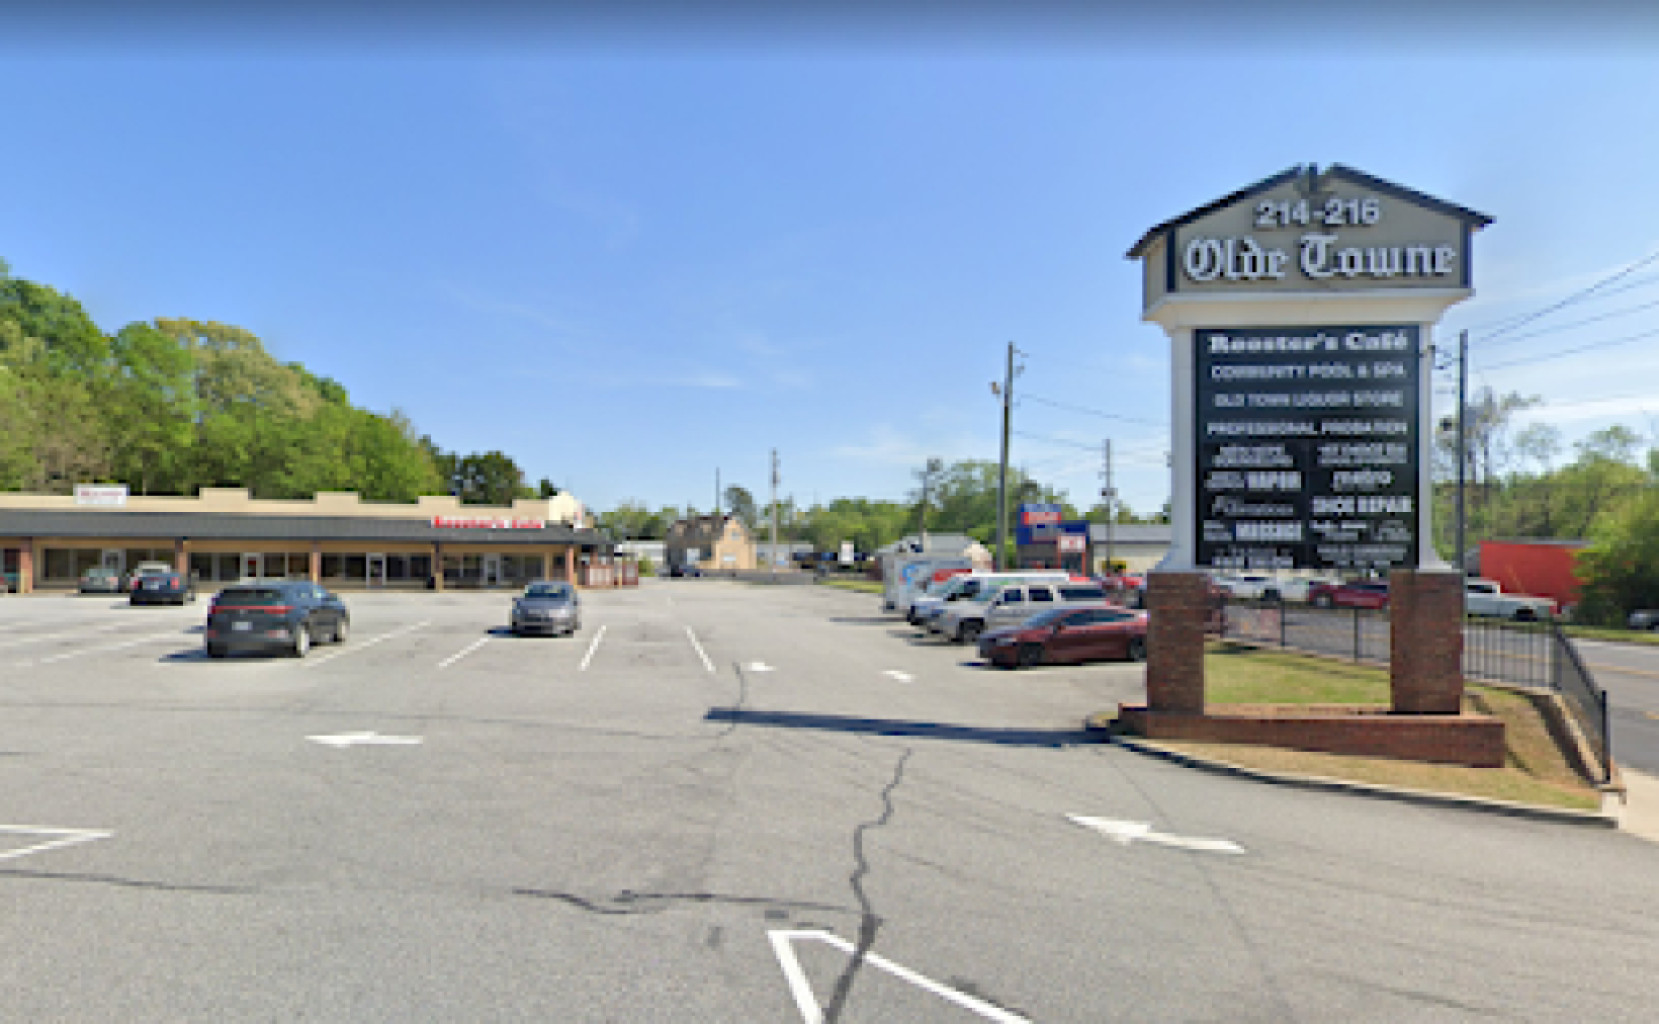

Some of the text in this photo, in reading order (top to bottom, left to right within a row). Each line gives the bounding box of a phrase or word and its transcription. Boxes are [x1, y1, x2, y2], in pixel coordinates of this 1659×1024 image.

[1255, 199, 1380, 227] 214-216
[1184, 234, 1456, 280] Olde Towne
[1208, 333, 1338, 353] Rooster's
